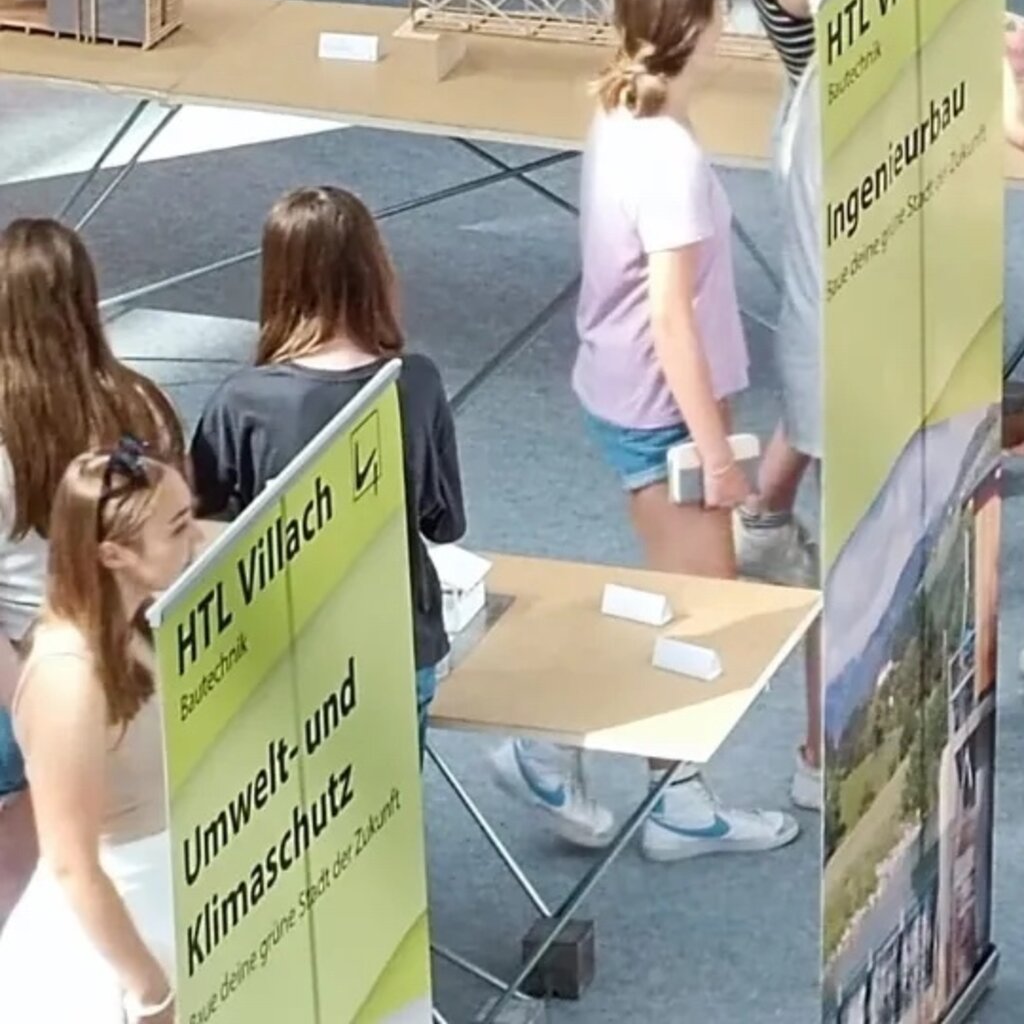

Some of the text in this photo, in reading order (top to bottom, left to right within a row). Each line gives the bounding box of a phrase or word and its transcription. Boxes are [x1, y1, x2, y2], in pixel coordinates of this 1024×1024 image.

[827, 81, 966, 248] Ingenieurbau
[176, 476, 333, 676] HTL Villach
[179, 634, 249, 722] Bautechnik
[183, 656, 358, 887] Umwelt- und
[186, 763, 355, 978] Klimaschutz
[221, 950, 257, 1002] deine
[259, 908, 296, 967] grüne
[298, 867, 331, 917] Stadt
[333, 845, 353, 880] der
[354, 788, 402, 856] Zukunft
